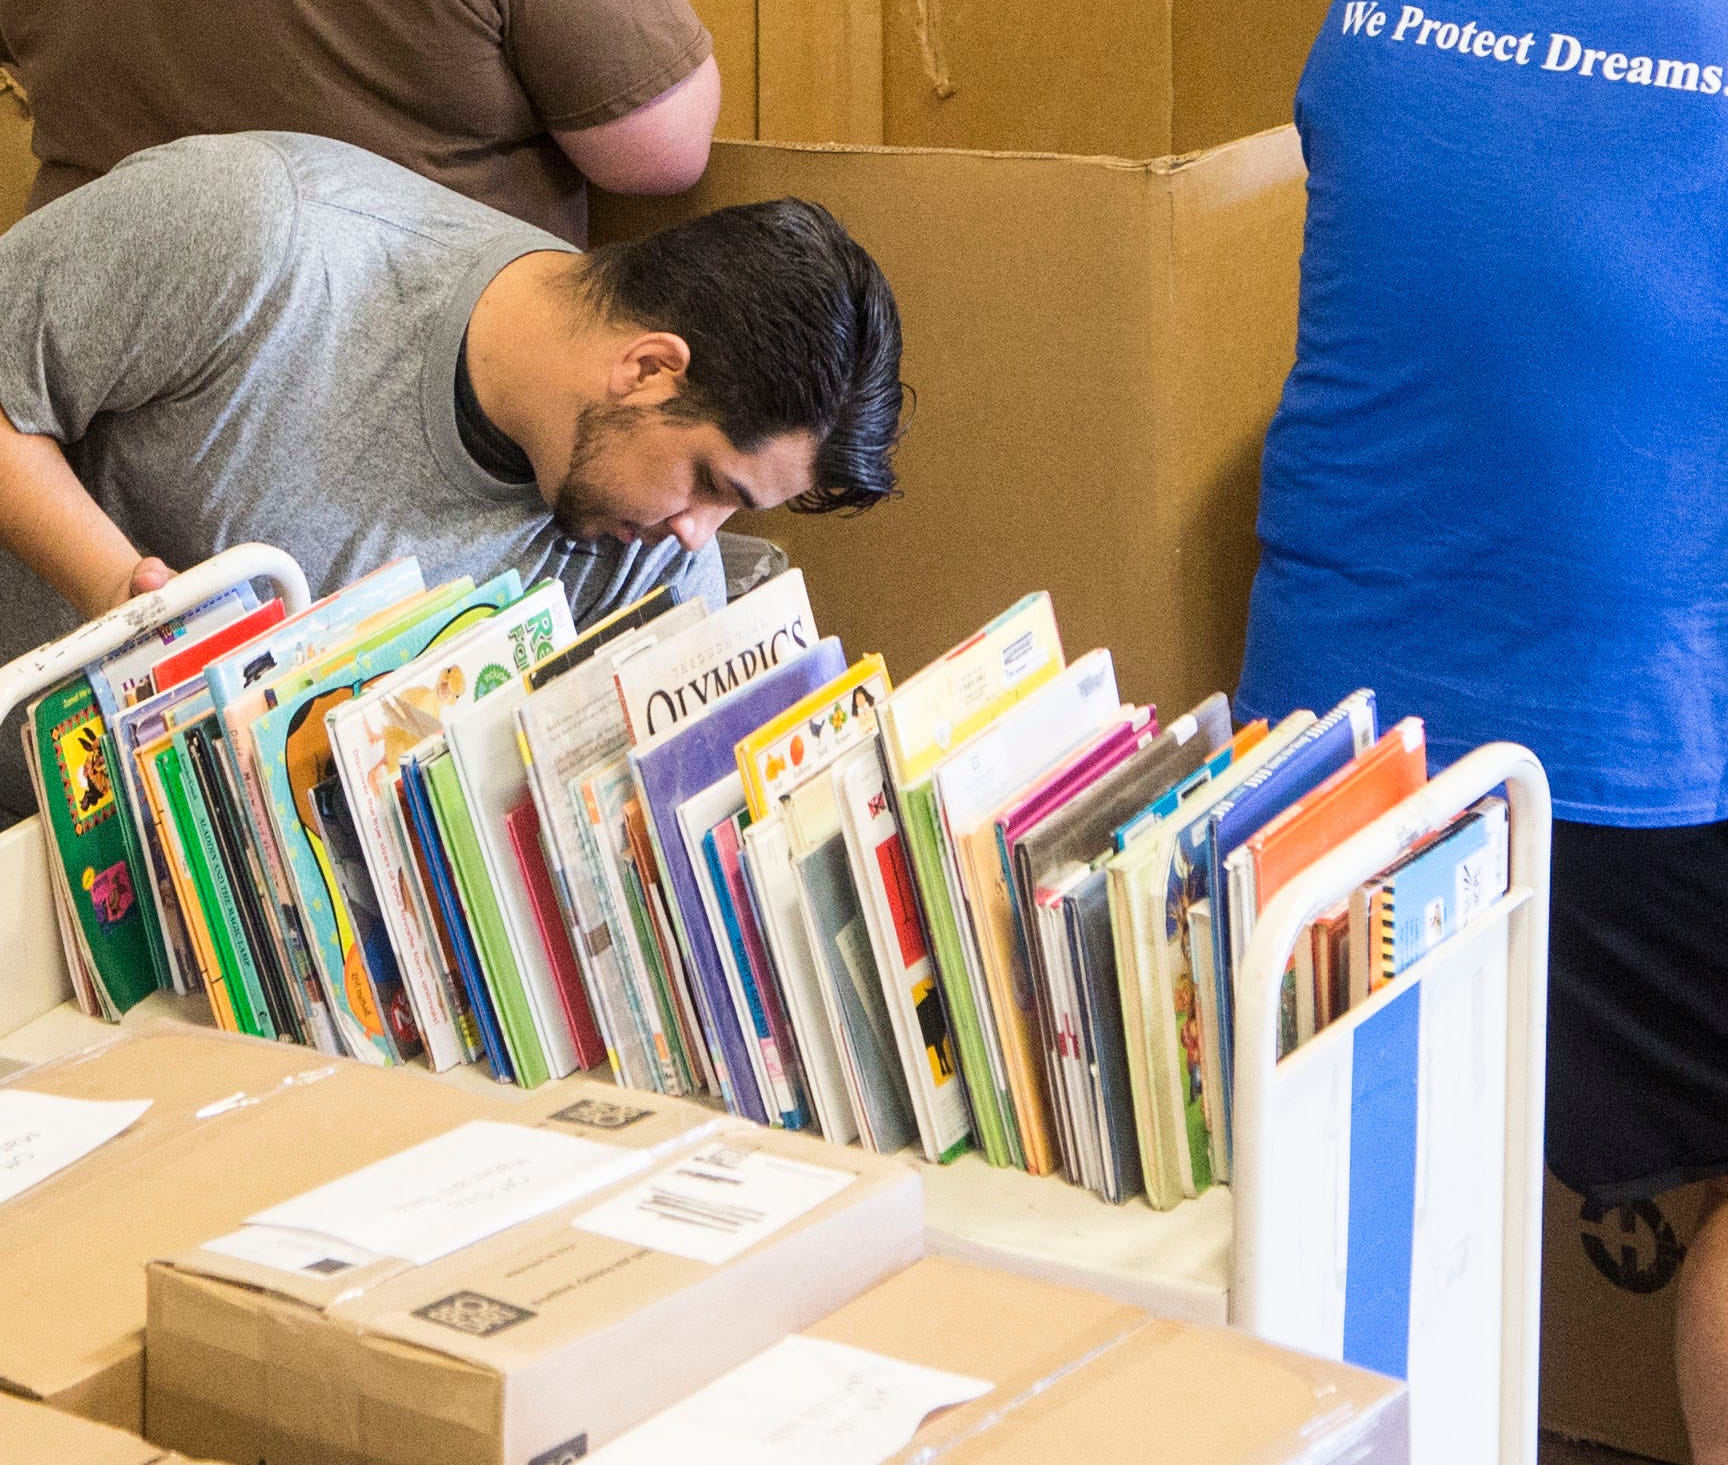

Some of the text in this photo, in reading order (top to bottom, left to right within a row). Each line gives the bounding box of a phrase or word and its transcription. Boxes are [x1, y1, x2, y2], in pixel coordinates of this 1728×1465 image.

[1342, 1, 1386, 38] We
[1391, 4, 1536, 66] Protect
[645, 617, 807, 737] OLYMPICS
[349, 747, 372, 795] Discover
[364, 797, 378, 816] the
[370, 816, 385, 839] true
[377, 841, 393, 865] sizes
[198, 817, 252, 967] ALADDIN AND THE MAGIC LAMP
[390, 882, 405, 907] your
[397, 908, 418, 948] favorite
[410, 950, 427, 977] farm
[418, 978, 441, 1025] animals!
